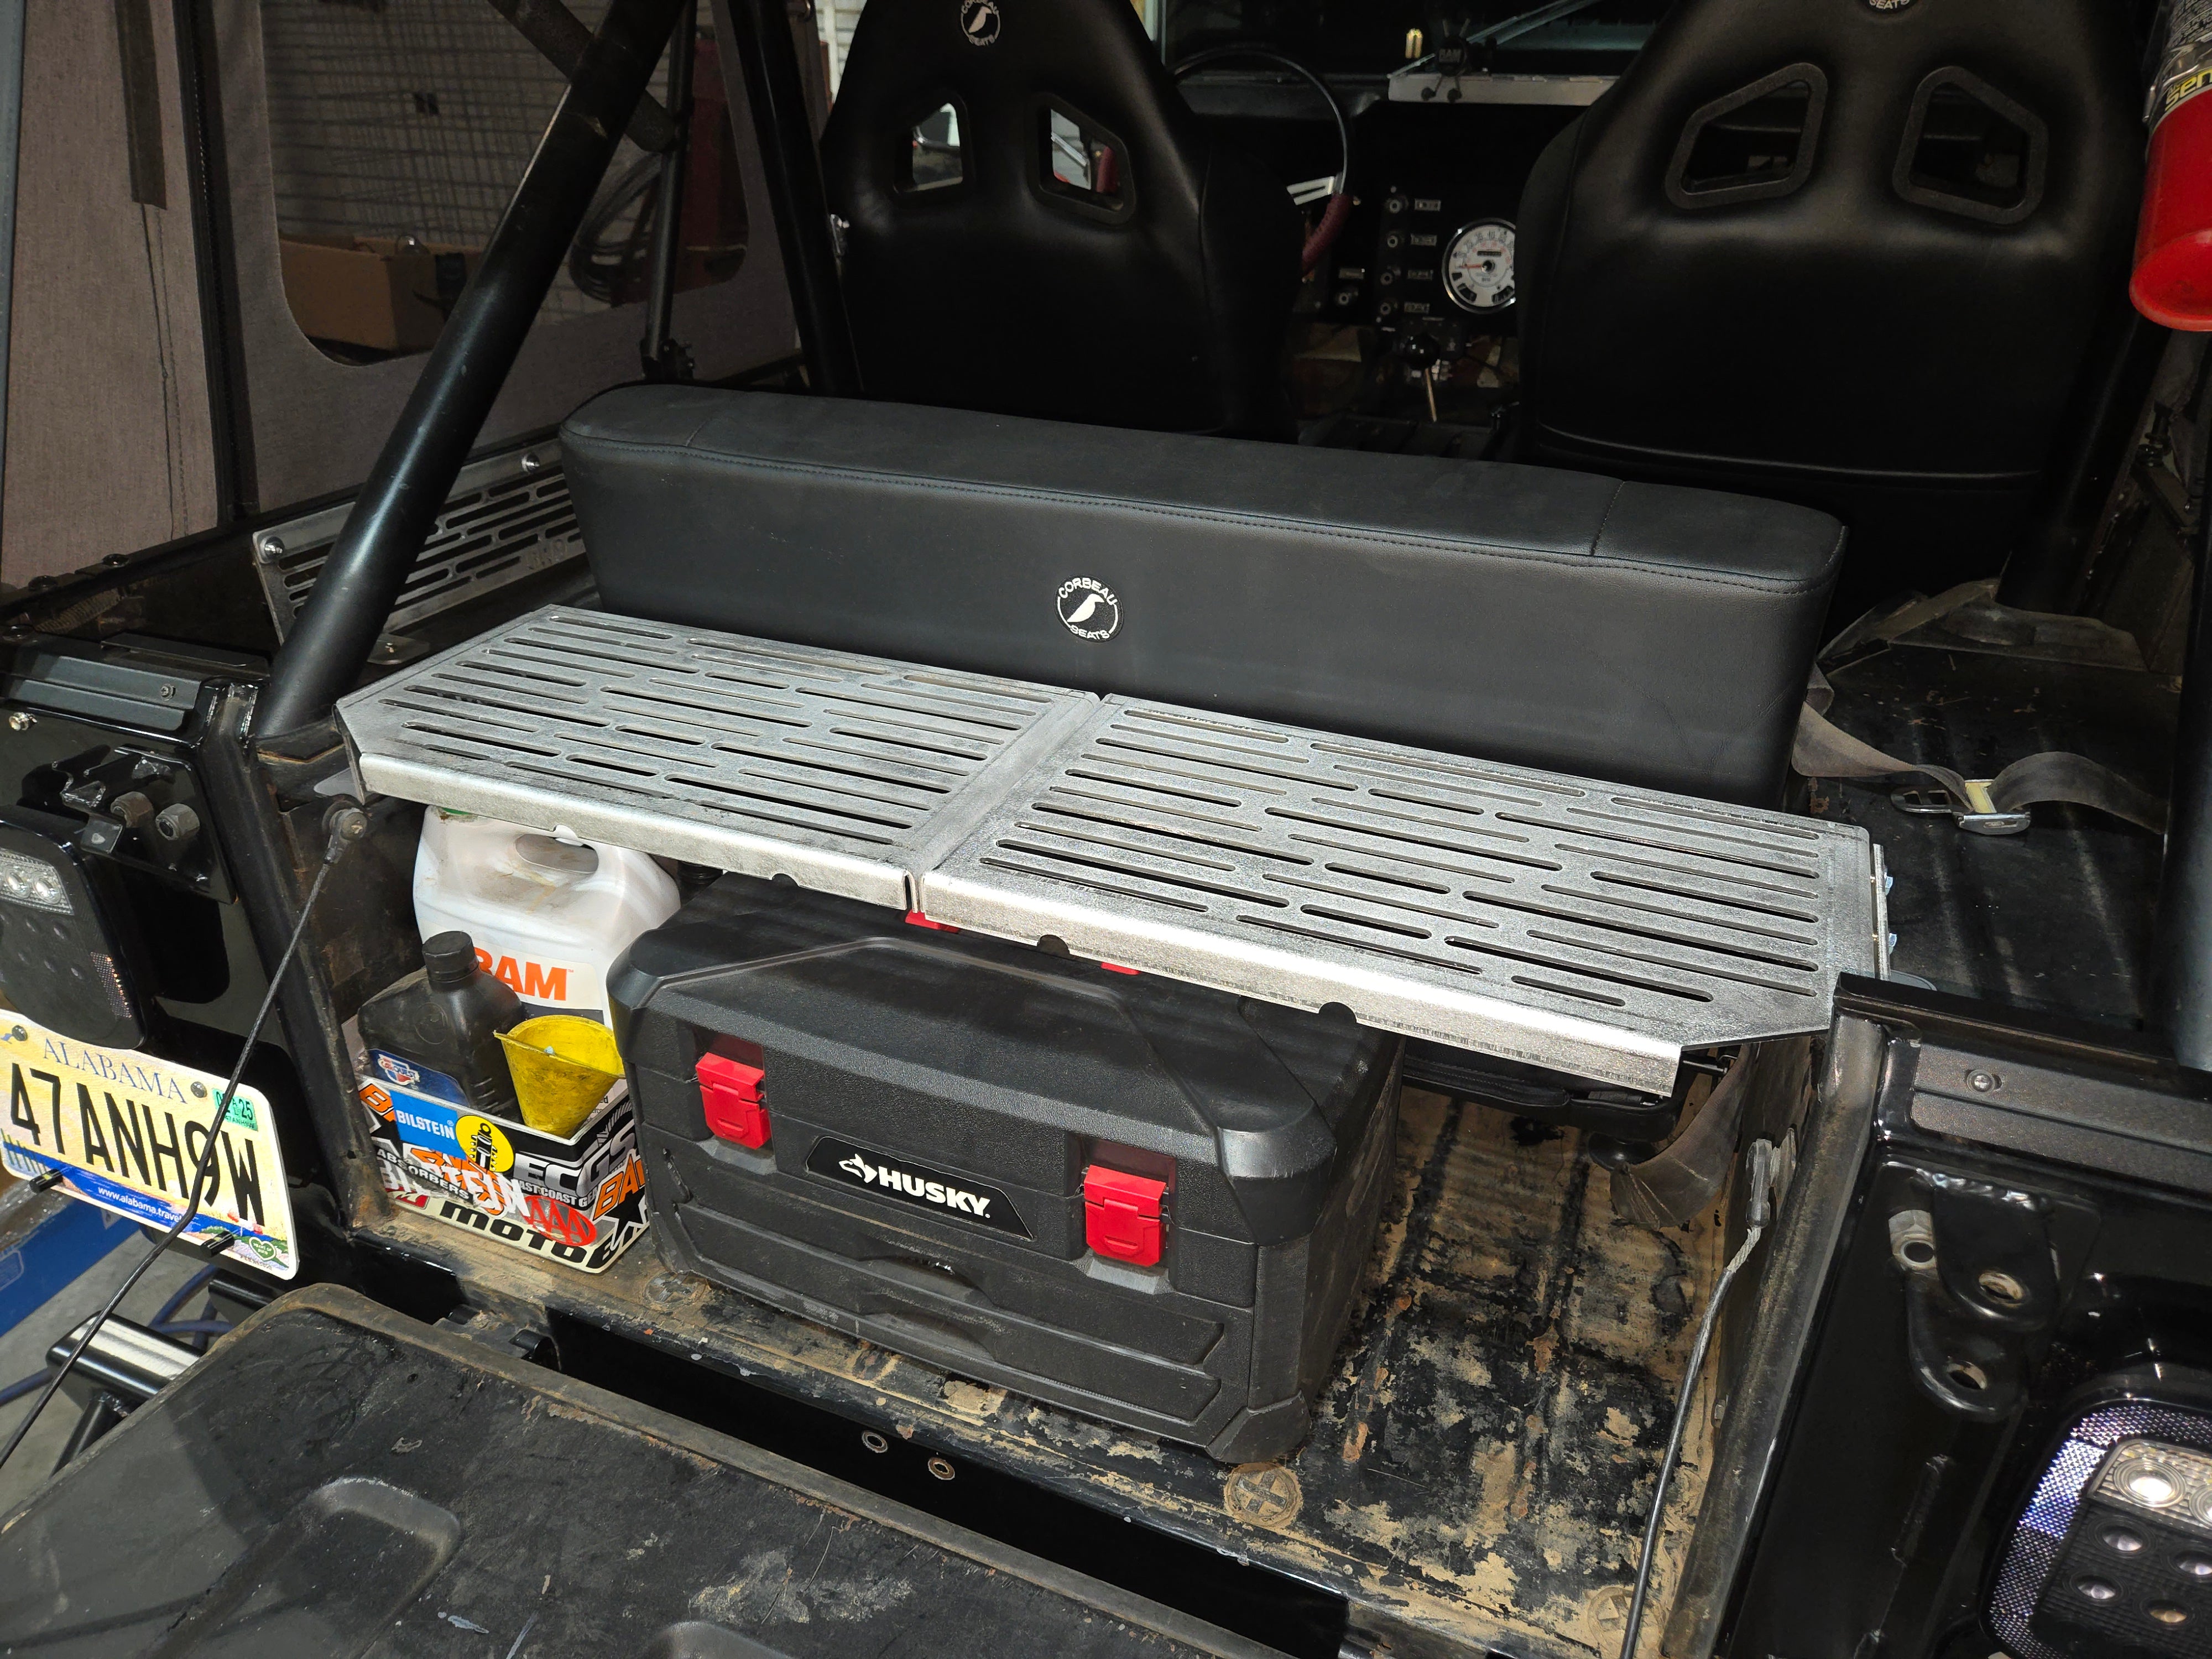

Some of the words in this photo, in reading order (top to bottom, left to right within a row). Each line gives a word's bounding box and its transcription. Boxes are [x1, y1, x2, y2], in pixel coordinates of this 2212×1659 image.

[1058, 577, 1118, 605] CORBEAU
[1070, 625, 1110, 639] SEATS
[43, 1038, 187, 1104] ALABAMA
[239, 1098, 253, 1120] 25
[396, 1110, 455, 1140] BILSTEIN
[11, 1063, 265, 1226] 47ANH9W
[377, 1149, 469, 1199] ABSORBERS
[519, 1180, 540, 1194] AST
[541, 1188, 577, 1206] COAST
[578, 1186, 598, 1207] GEA
[879, 1166, 990, 1218] HUSKY
[523, 1196, 592, 1245] AAA
